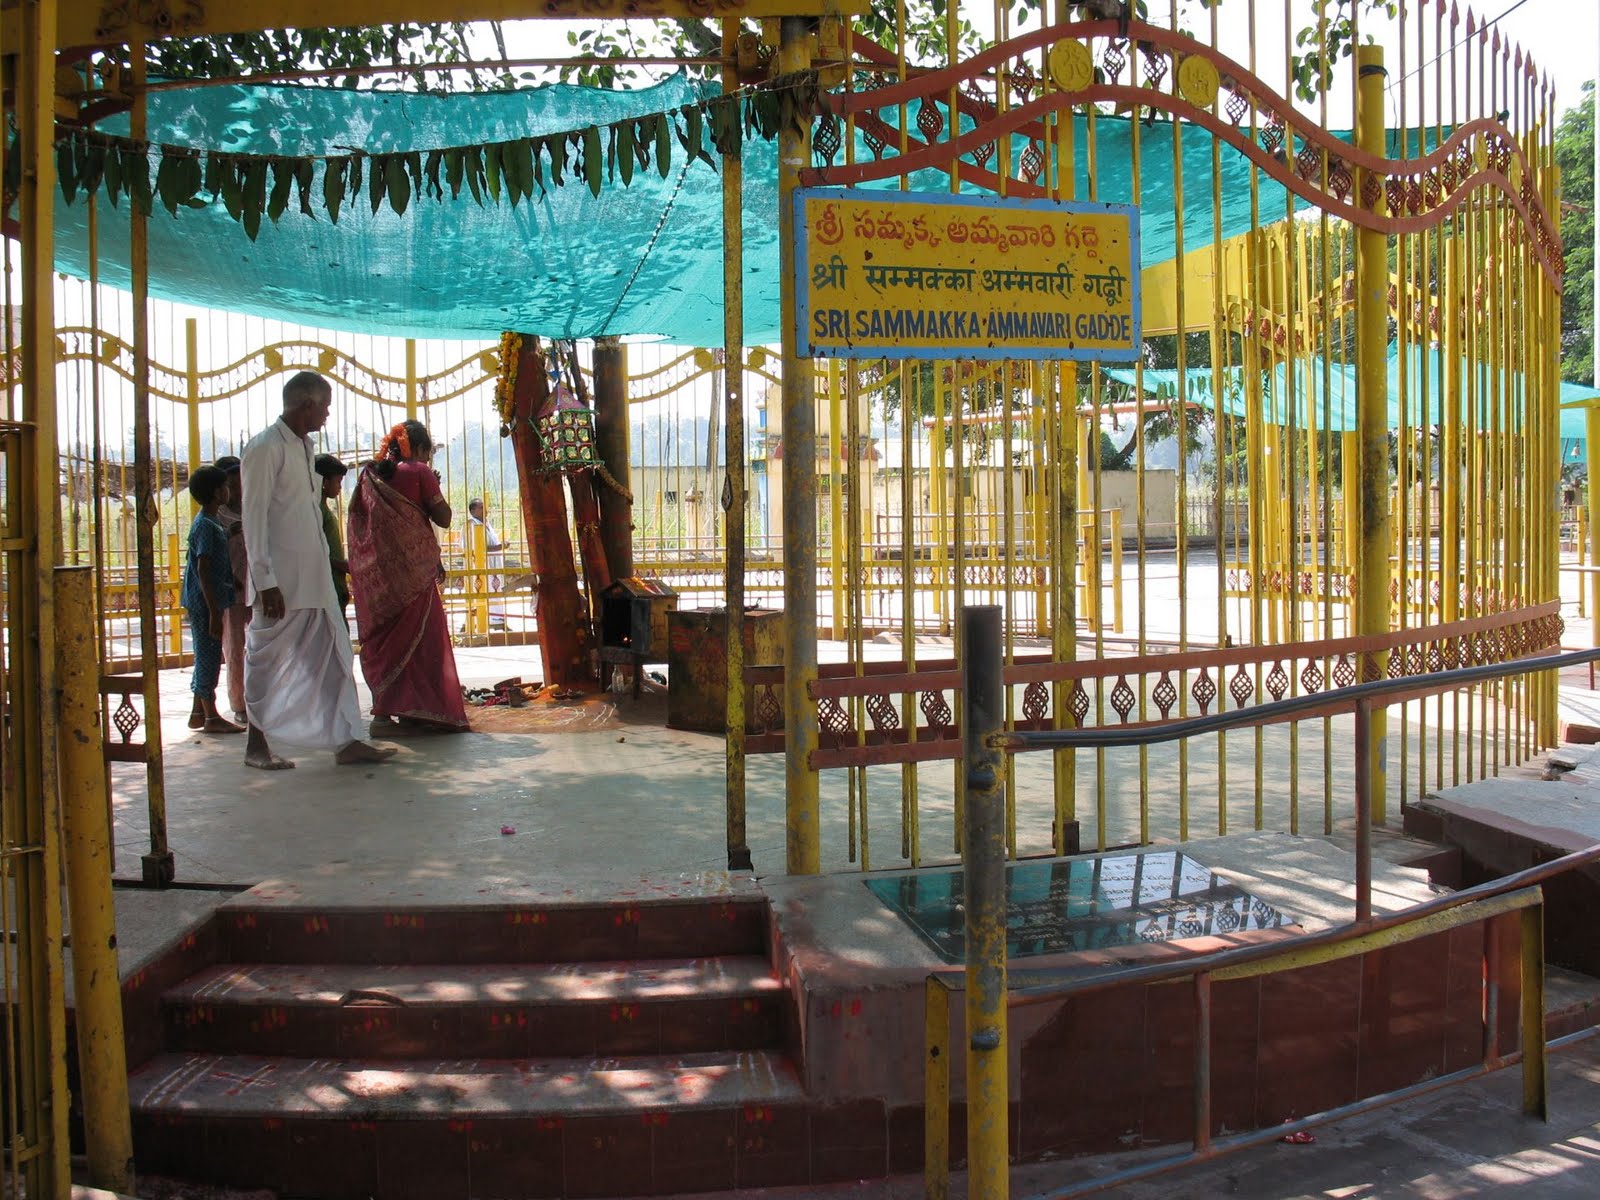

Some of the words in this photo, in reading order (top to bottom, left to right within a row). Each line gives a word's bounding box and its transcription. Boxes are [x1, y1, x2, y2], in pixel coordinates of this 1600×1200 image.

[815, 203, 844, 246] శ్రీ
[852, 209, 942, 250] సమ్మక్క
[946, 215, 1056, 254] అమ్మవారి
[811, 254, 848, 291] श्री
[862, 265, 977, 295] सम्मक्का
[980, 262, 1075, 300] अम्मवारी
[813, 308, 850, 339] SRI
[856, 309, 981, 340] SAMMAKKA
[986, 311, 1072, 340] AMMAVARI
[1075, 313, 1131, 341] GADDE
